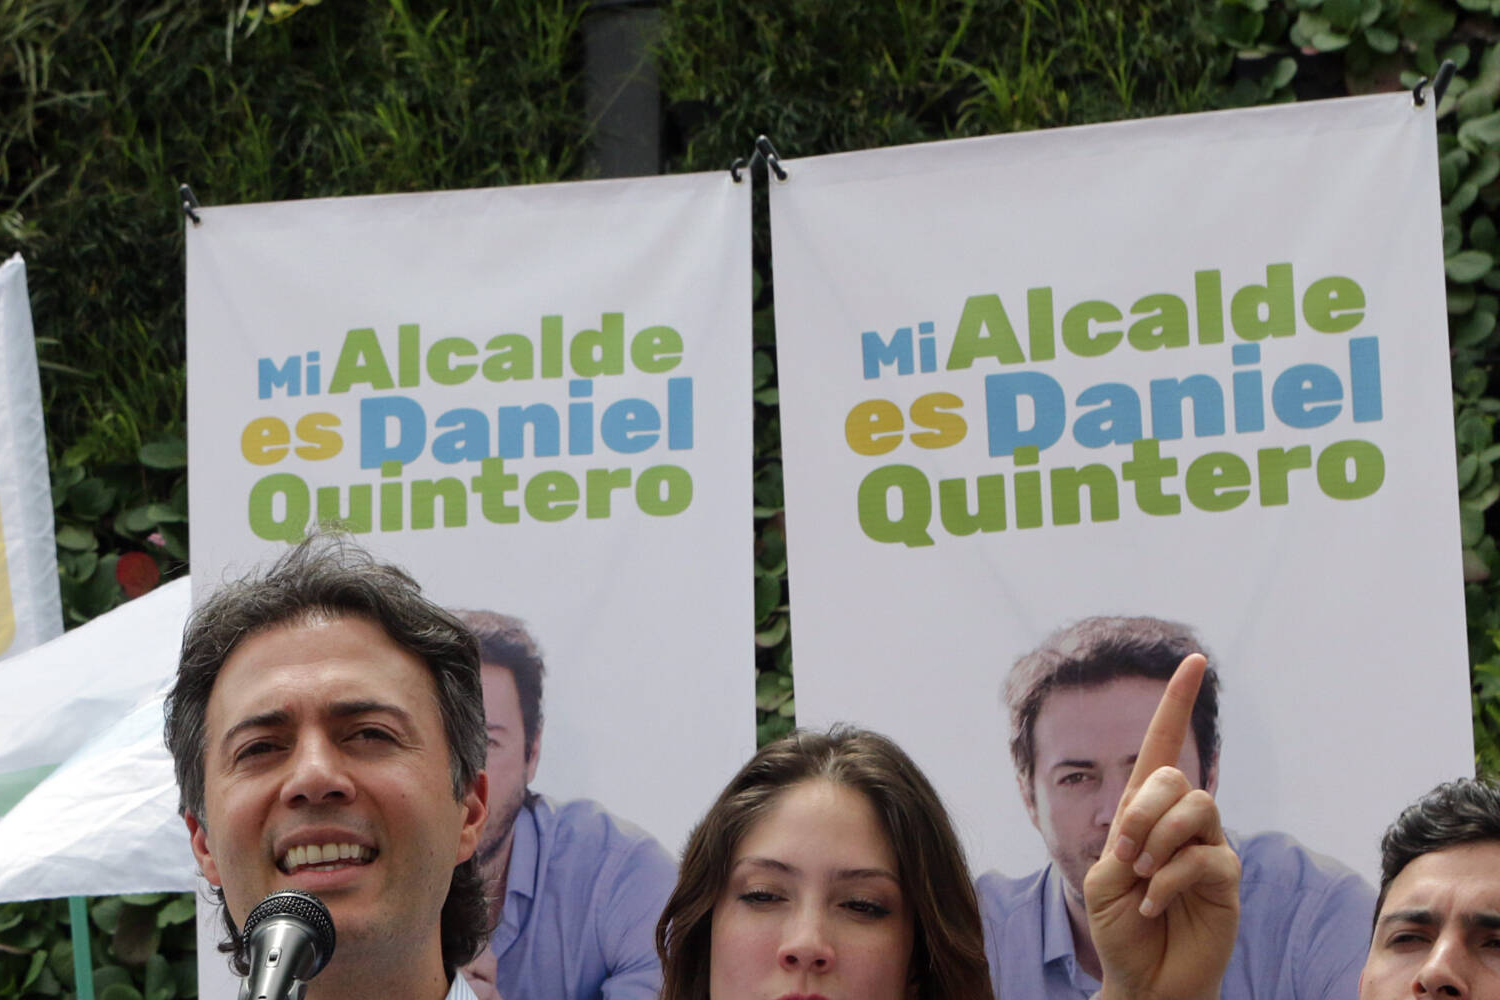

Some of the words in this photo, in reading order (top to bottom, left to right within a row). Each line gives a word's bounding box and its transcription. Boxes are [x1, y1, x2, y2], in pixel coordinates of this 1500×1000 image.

[258, 351, 320, 399] Mi
[328, 312, 684, 394] Alcalde
[861, 321, 937, 380] Mi
[946, 263, 1366, 370] Alcalde
[240, 411, 344, 466] es
[360, 377, 694, 469] Daniel
[845, 392, 968, 456] es
[985, 336, 1384, 458] Daniel
[248, 457, 694, 544] Quintero
[857, 438, 1386, 548] Quintero
